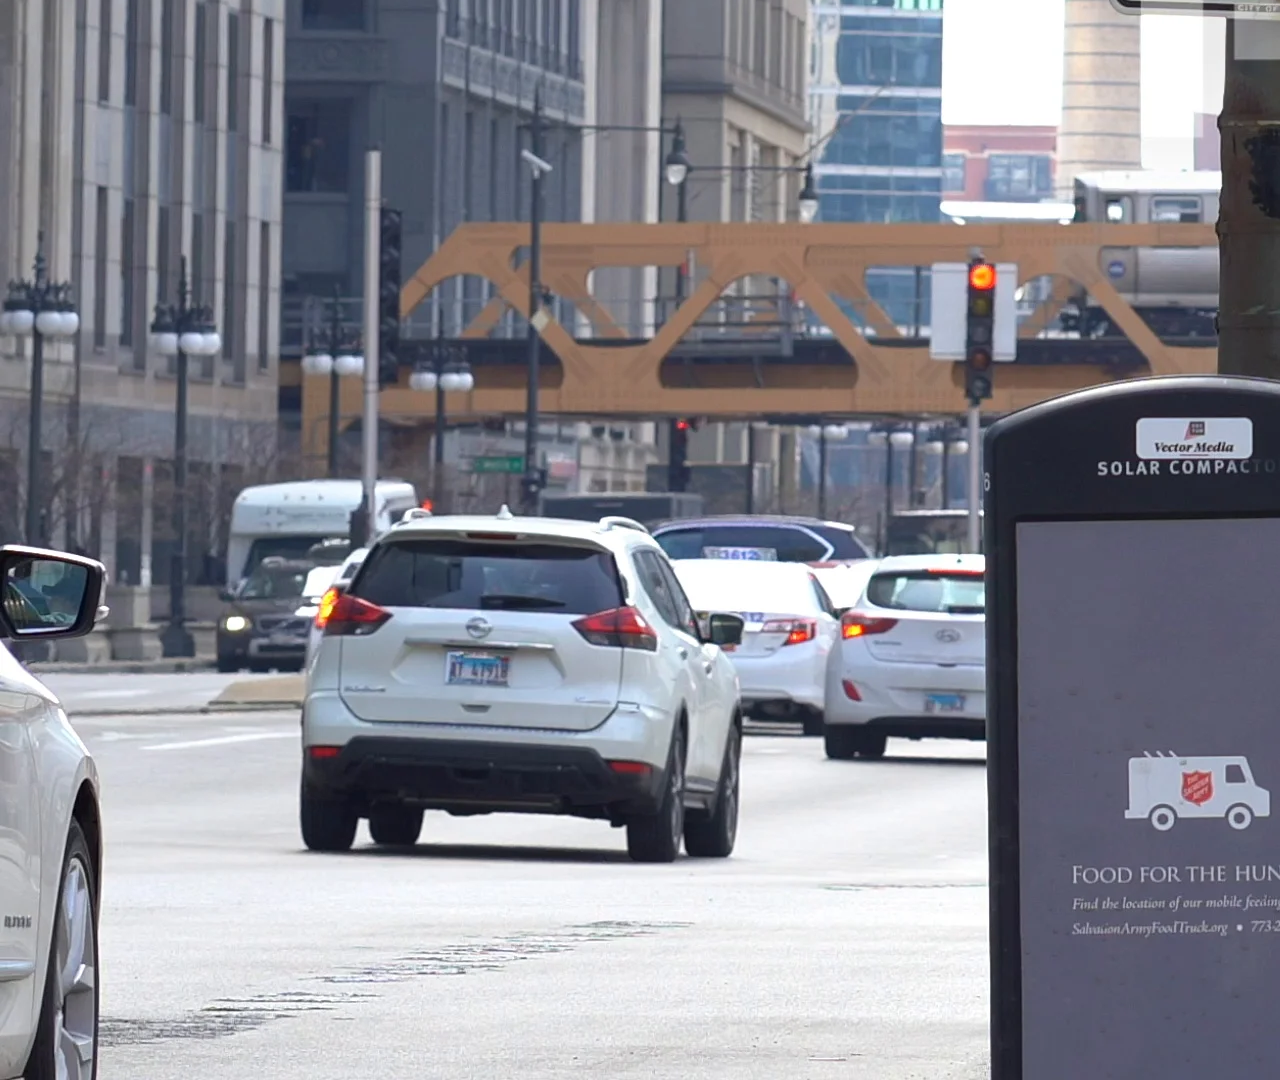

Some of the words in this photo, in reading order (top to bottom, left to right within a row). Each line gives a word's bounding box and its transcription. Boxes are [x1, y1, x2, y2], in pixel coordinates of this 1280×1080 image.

[1237, 3, 1260, 12] CITY
[1265, 4, 1278, 13] OF
[1154, 442, 1193, 453] Vector
[1194, 441, 1234, 453] Media
[1097, 461, 1161, 476] SOLAR
[1072, 865, 1133, 884] FOOD
[1140, 866, 1182, 883] FOR
[1186, 865, 1227, 882] THE
[1072, 897, 1099, 910] Find
[1102, 896, 1119, 909] the
[1122, 896, 1166, 909] location
[1169, 895, 1182, 912] of
[1183, 899, 1202, 908] our
[1206, 895, 1242, 908] mobile
[1072, 920, 1228, 938] SalvationArmyFoodTruck.org
